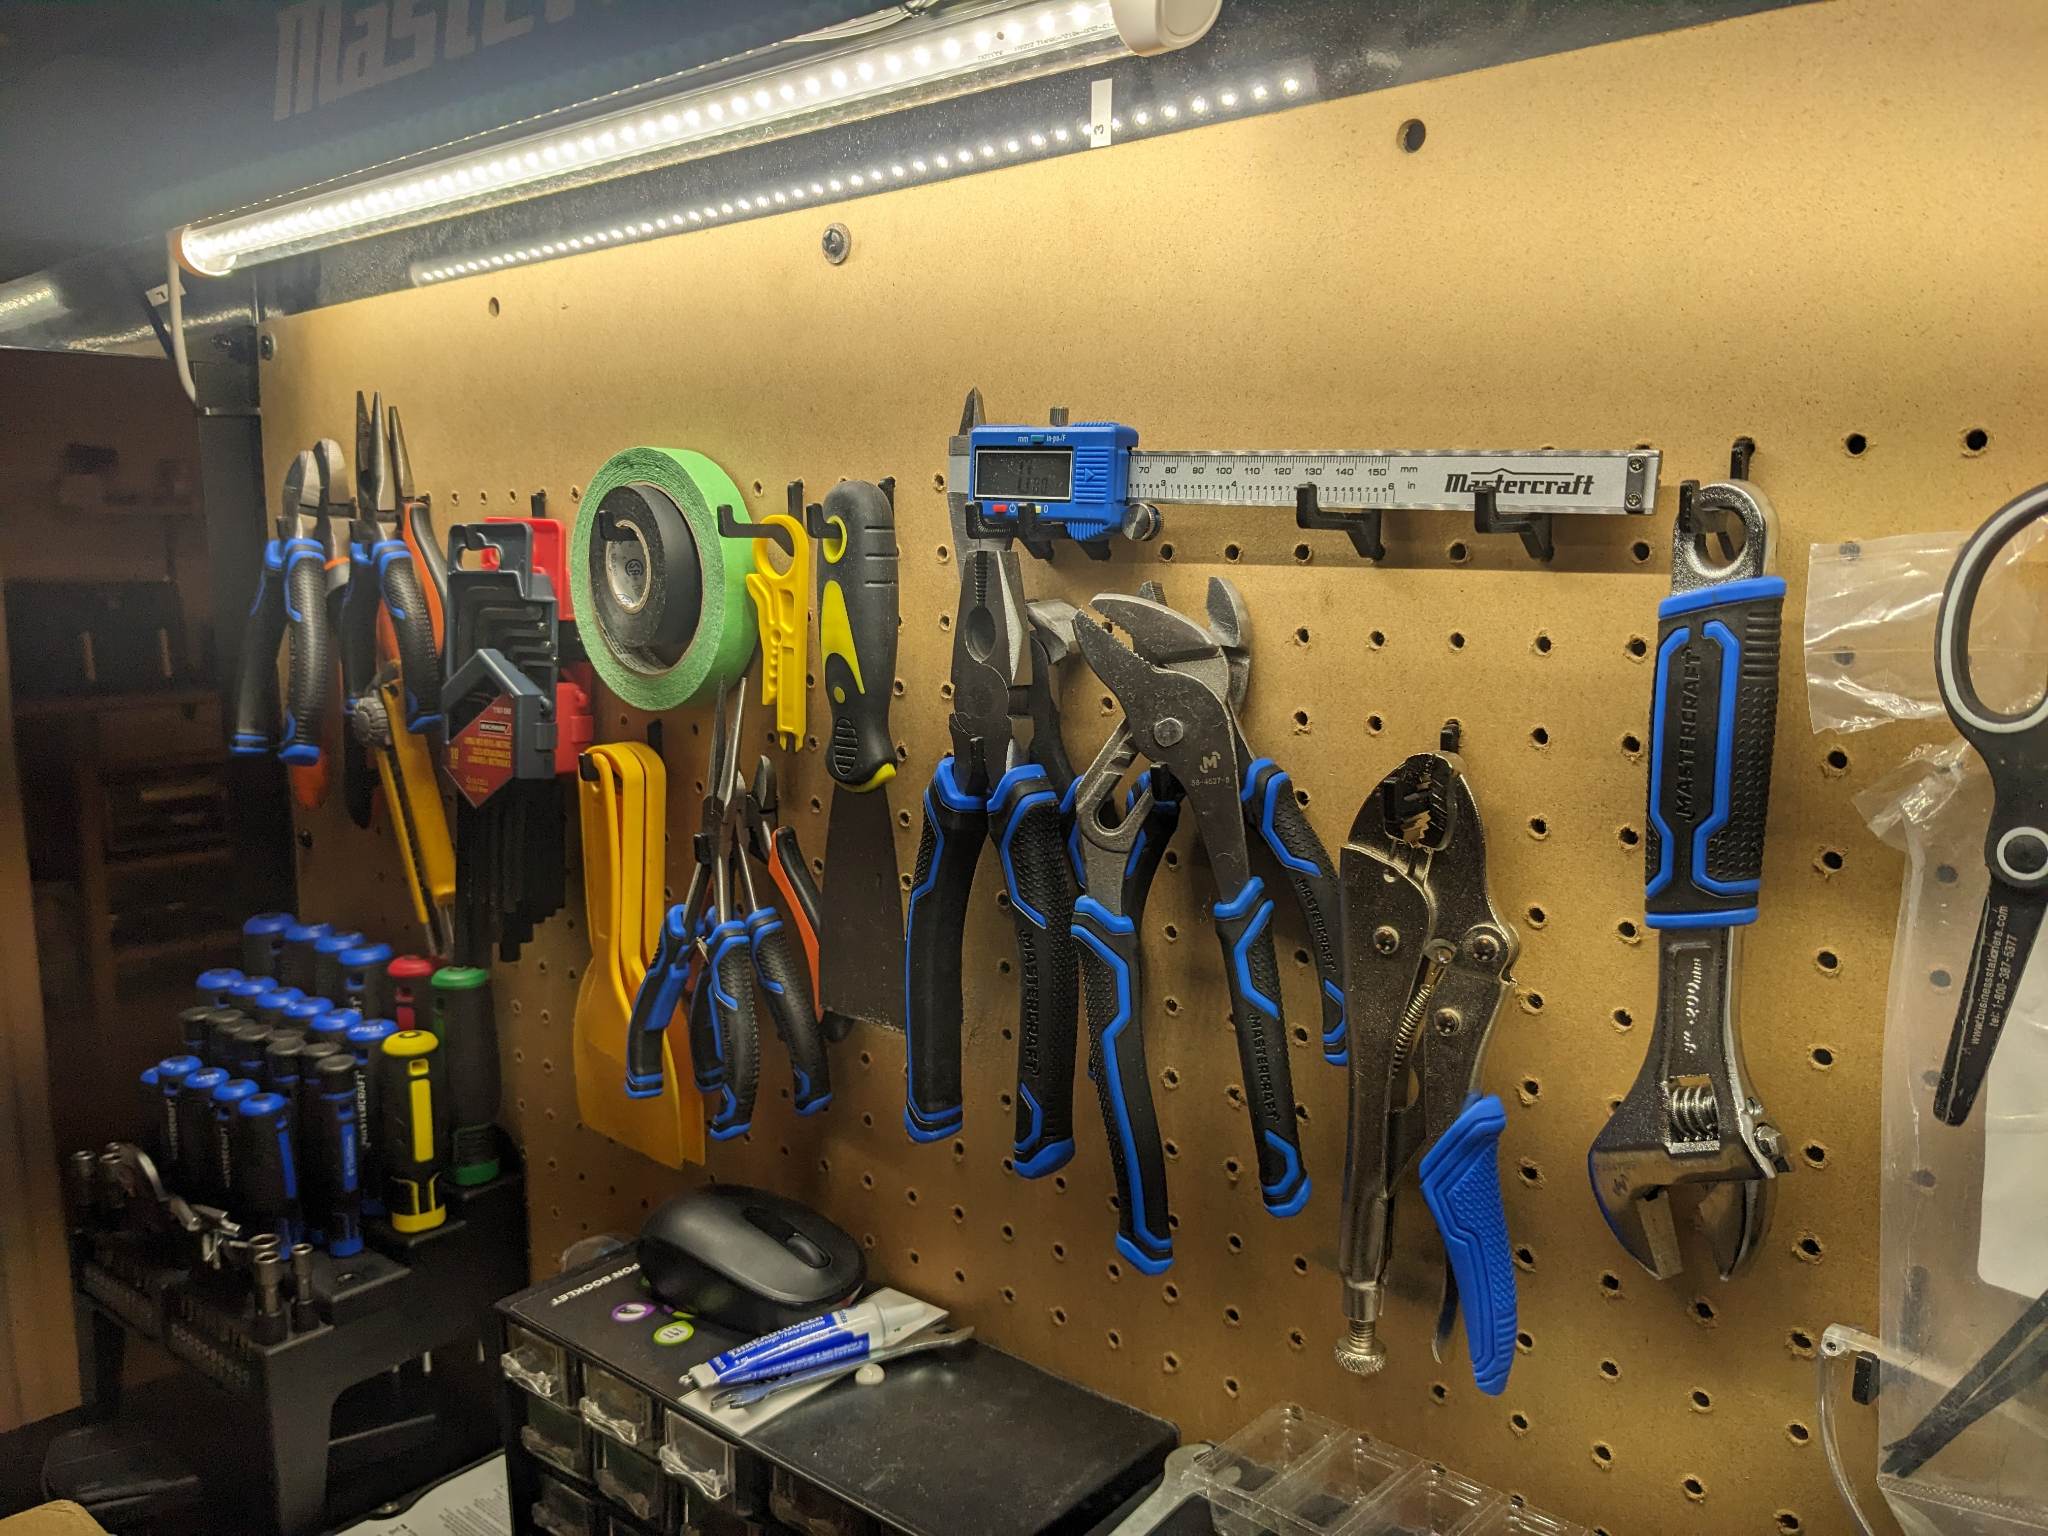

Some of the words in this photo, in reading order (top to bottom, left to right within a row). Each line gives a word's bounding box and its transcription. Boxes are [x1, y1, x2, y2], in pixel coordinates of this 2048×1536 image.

[1216, 467, 1232, 475] 100
[1244, 467, 1261, 475] 110
[1305, 468, 1322, 476] 130
[1336, 468, 1354, 476] 140
[1368, 468, 1387, 476] 150
[1388, 482, 1394, 490] 6
[1407, 481, 1416, 490] in
[1445, 474, 1595, 495] Mastercraft
[1675, 644, 1701, 823] MASTERCRAFT
[1247, 1012, 1280, 1123] MASTERCRAFT
[612, 1262, 641, 1280] PON
[551, 1275, 612, 1307] BOOKLET
